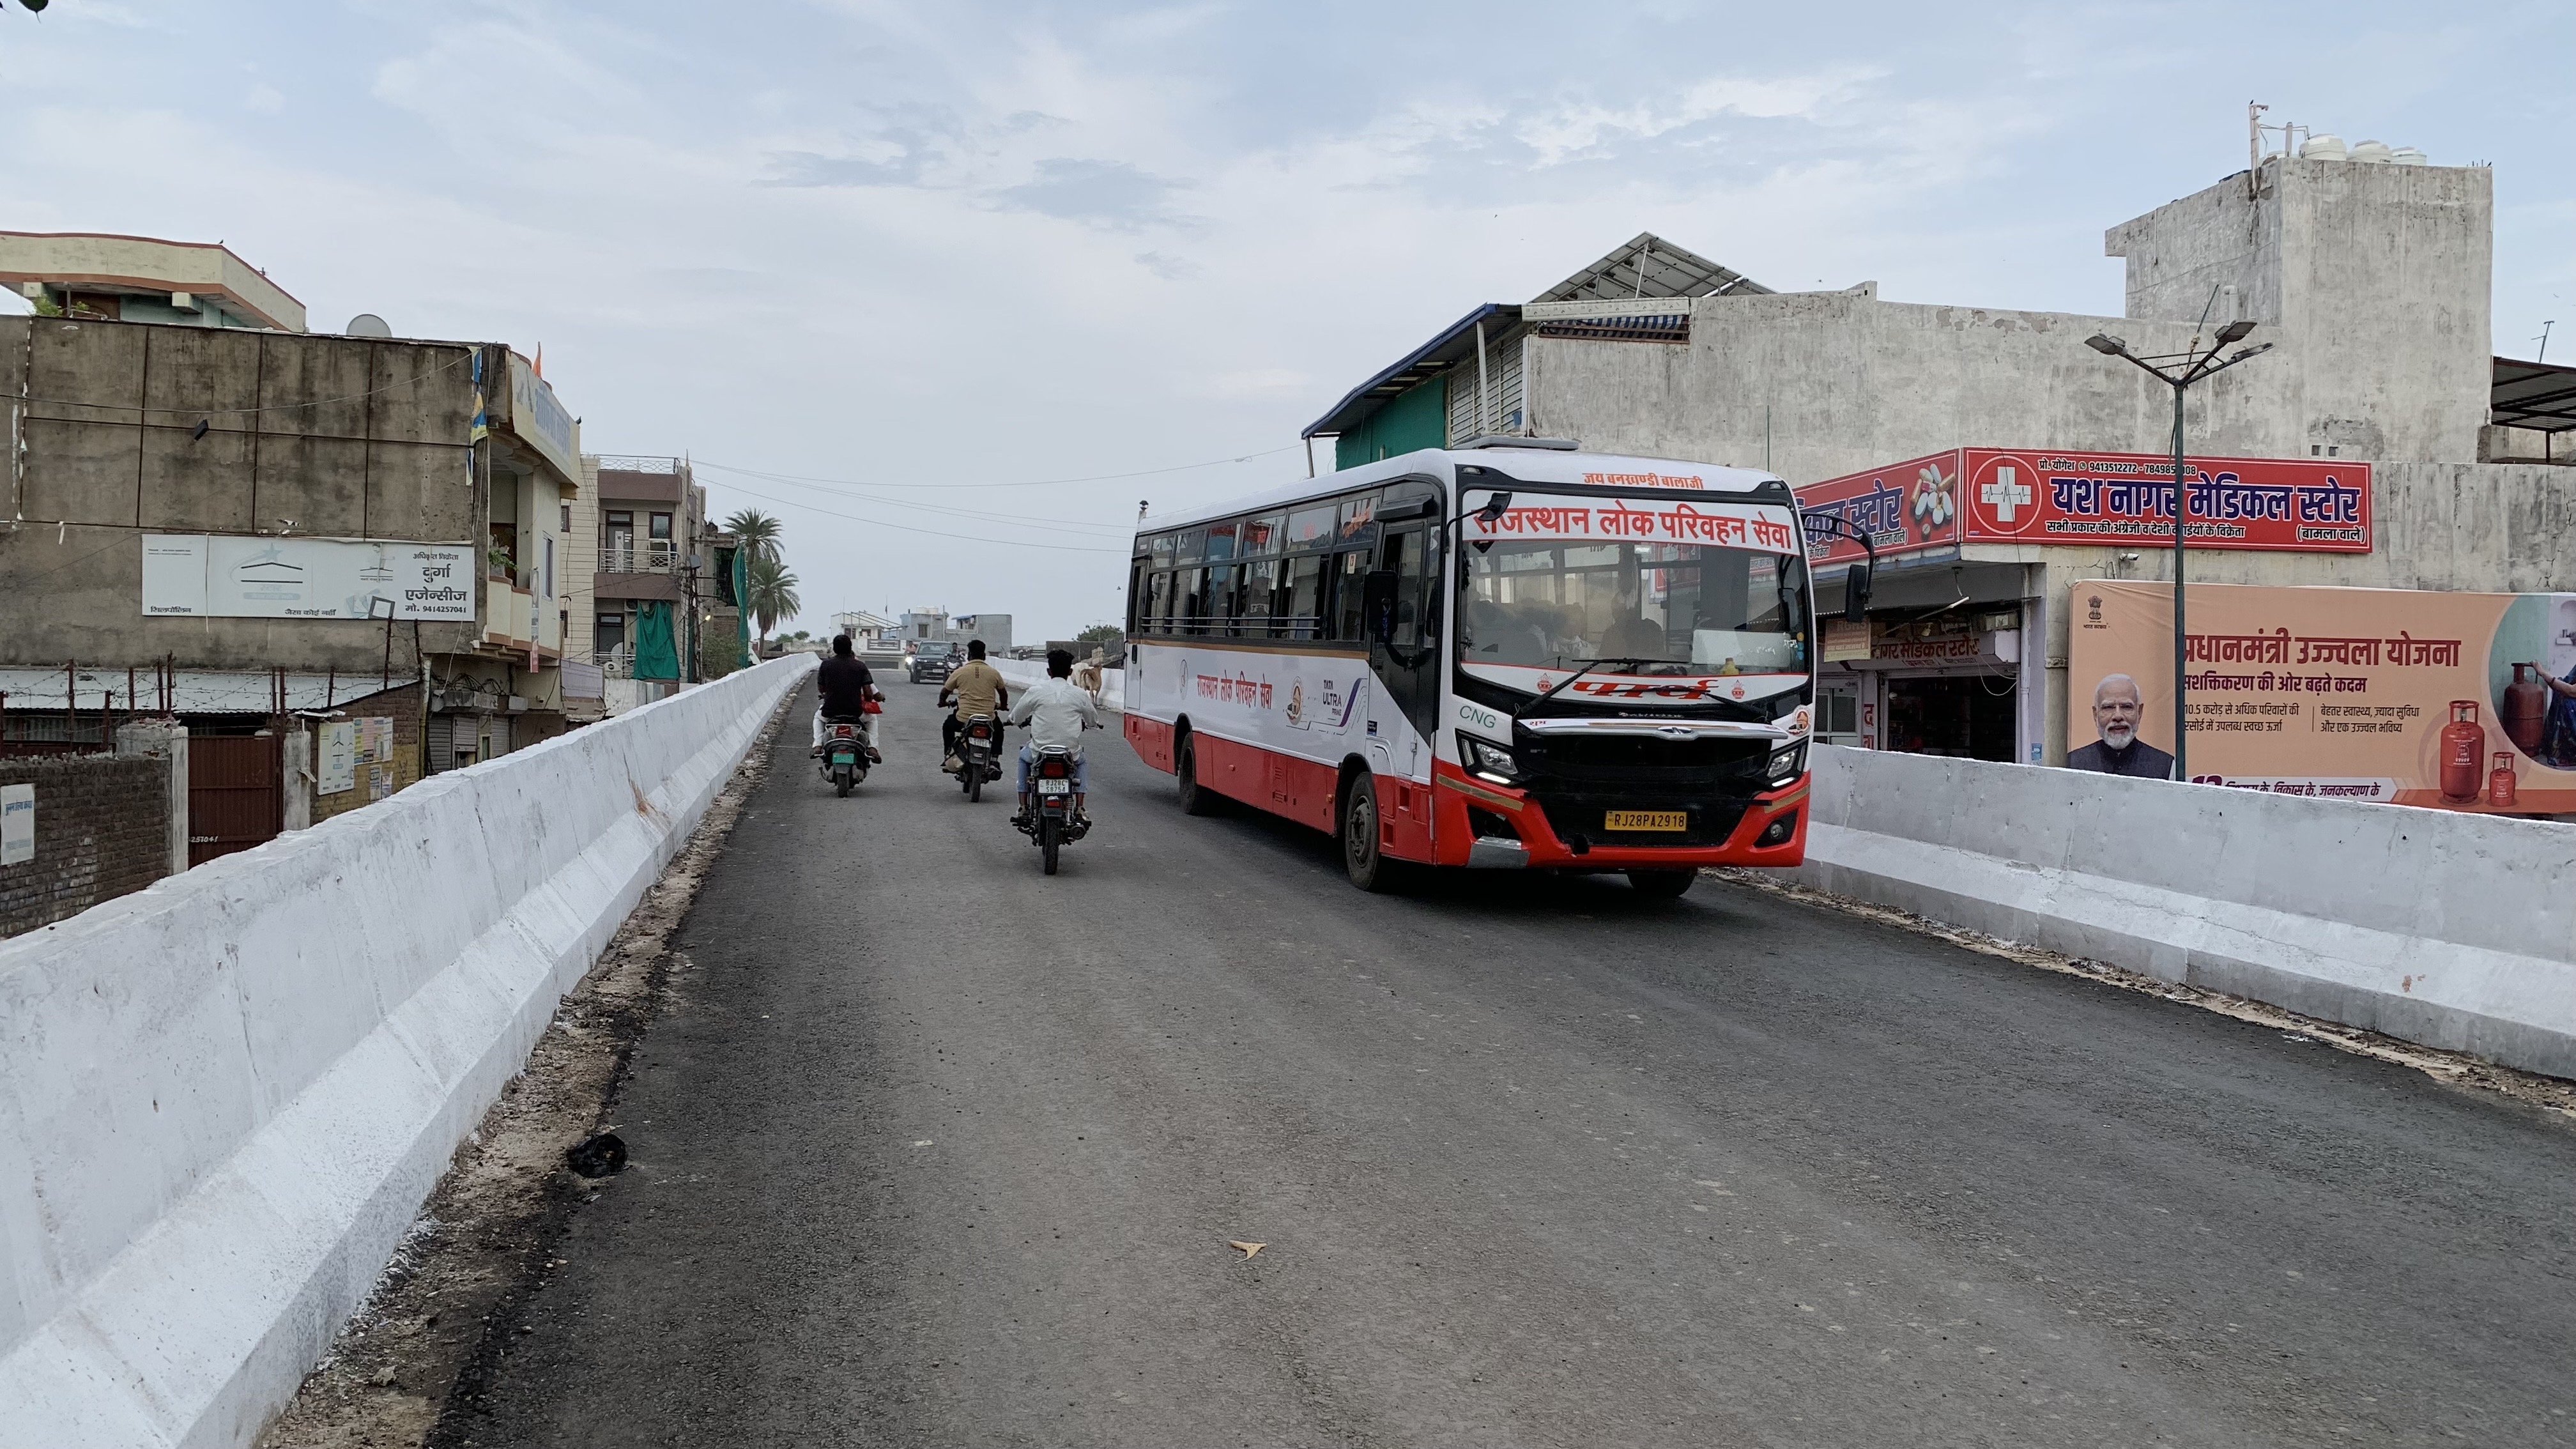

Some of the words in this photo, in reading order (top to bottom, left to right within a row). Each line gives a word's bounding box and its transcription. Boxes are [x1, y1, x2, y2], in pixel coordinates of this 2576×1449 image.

[2052, 459, 2075, 471] योगेश
[2089, 463, 2137, 473] 9413512272
[2145, 464, 2196, 475] 78498508
[1582, 473, 1604, 484] जय
[1660, 476, 1704, 490] बालाजी
[2050, 478, 2104, 514] यश
[2186, 471, 2294, 521] मेडिकल
[2297, 477, 2360, 522] स्टोर
[1848, 479, 1904, 537] स्टोर
[1597, 500, 1654, 535] लोक
[1659, 503, 1745, 544] परिवहन
[1751, 511, 1791, 549] सेवा
[2046, 519, 2069, 532] सभी
[2071, 522, 2097, 533] प्रकार
[2098, 521, 2110, 532] की
[2113, 522, 2140, 534] अंग्रेजी
[2143, 525, 2149, 533] व
[2150, 523, 2169, 534] देशी
[2205, 524, 2215, 535] के
[2217, 524, 2244, 536] विक्रेता
[2298, 525, 2336, 542] (बामला
[2340, 528, 2365, 542] वाले)
[422, 564, 451, 583] दुर्गा
[405, 586, 467, 601] एजेन्सीज
[2184, 627, 2291, 664] प्रधानमंत्री
[2295, 637, 2382, 665] उज्ज्वला
[2385, 631, 2461, 666] योजना
[1324, 680, 1333, 689] TATA
[2184, 671, 2254, 691] सशक्तिकरण
[2257, 671, 2274, 691] की
[2278, 672, 2302, 692] ओर
[2305, 673, 2332, 696] बढ़ते
[2334, 678, 2367, 693] कदम
[1323, 692, 1342, 707] ULTRA
[1459, 705, 1496, 728] CNG
[2184, 703, 2200, 714] 10.5
[2203, 704, 2223, 716] करोड़
[2225, 703, 2233, 715] से
[2235, 703, 2257, 716] अधिक
[2259, 703, 2288, 716] परिवारों
[2289, 703, 2299, 716] की
[2320, 705, 2341, 717] बेहतर
[2396, 705, 2419, 719] सुविधा
[2184, 719, 2204, 732] रसोई
[2205, 719, 2214, 732] में
[2215, 721, 2242, 732] उपलब्ध
[2244, 721, 2264, 732] स्वच्छ
[2266, 719, 2283, 732] ऊर्जा
[2320, 722, 2334, 733] और
[2337, 724, 2350, 733] एक
[2379, 722, 2403, 733] भविष्य
[2319, 785, 2368, 796] जनकल्याण
[2371, 781, 2381, 796] के
[1614, 814, 1685, 827] RJ28PA2918
